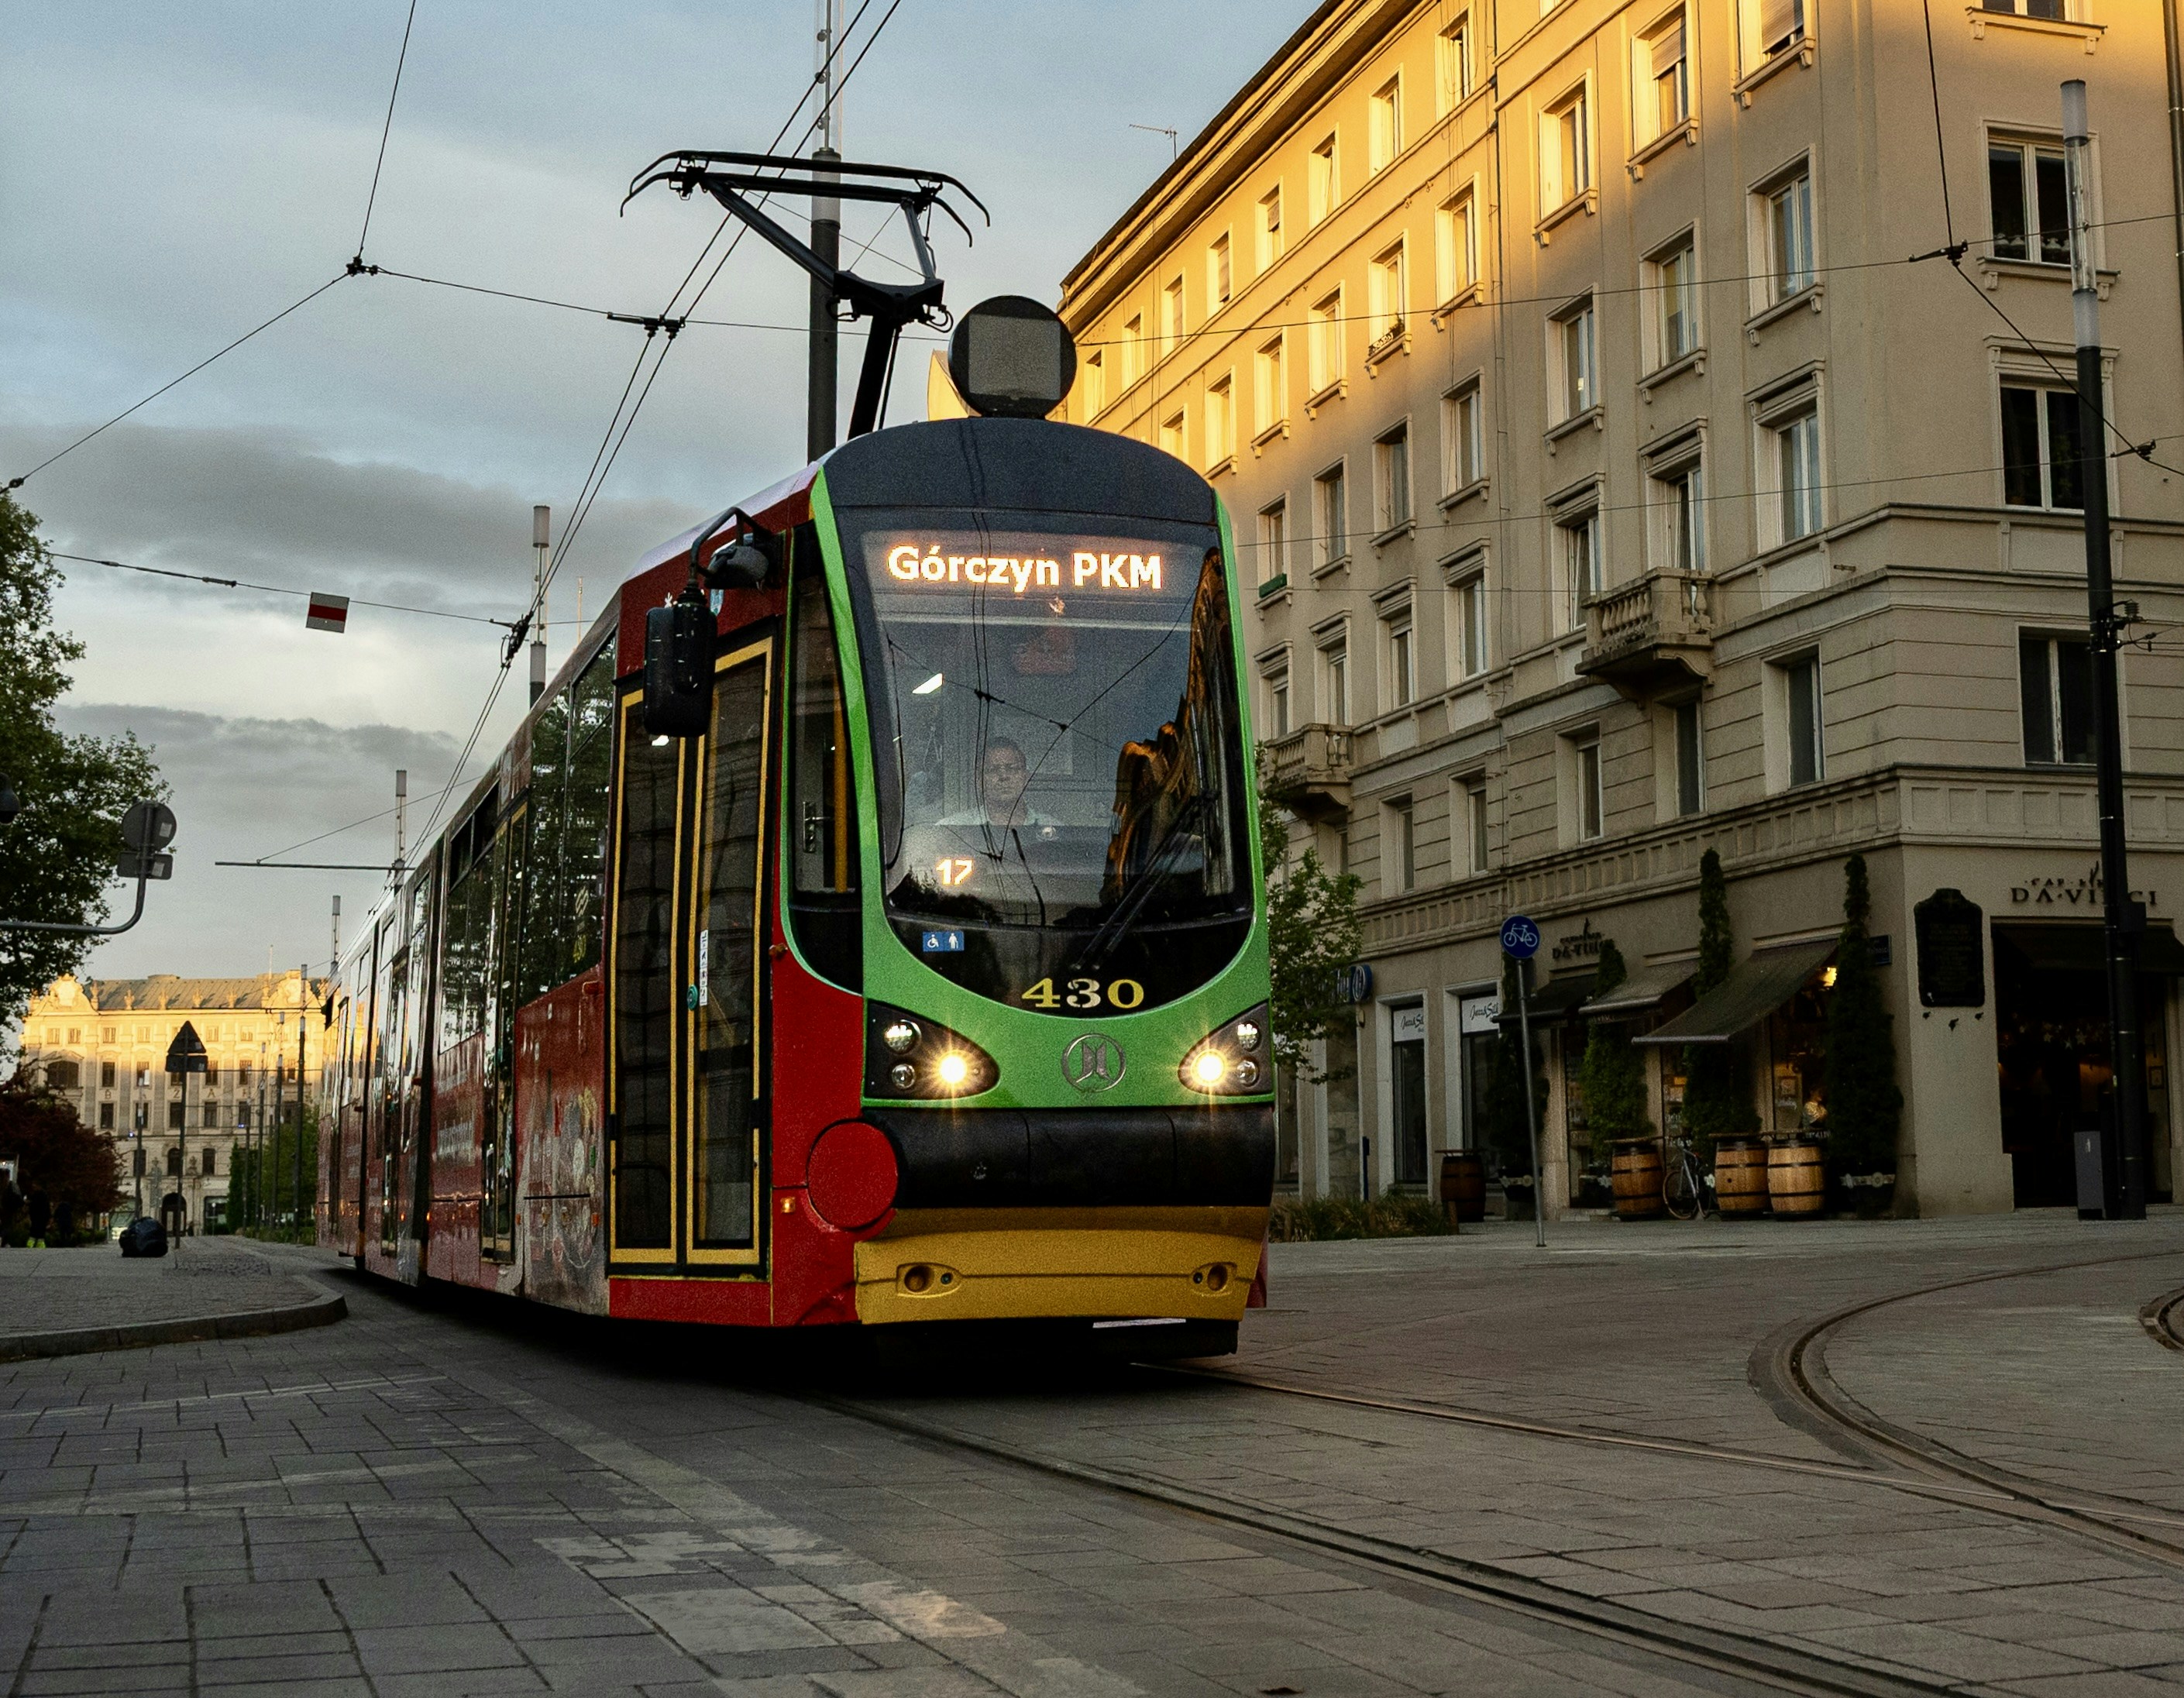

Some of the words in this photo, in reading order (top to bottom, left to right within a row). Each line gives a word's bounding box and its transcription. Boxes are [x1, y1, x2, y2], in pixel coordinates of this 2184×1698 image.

[887, 545, 1060, 593] Górczyn
[1072, 551, 1162, 590] PKM
[935, 858, 974, 885] 17
[1021, 978, 1144, 1009] 430
